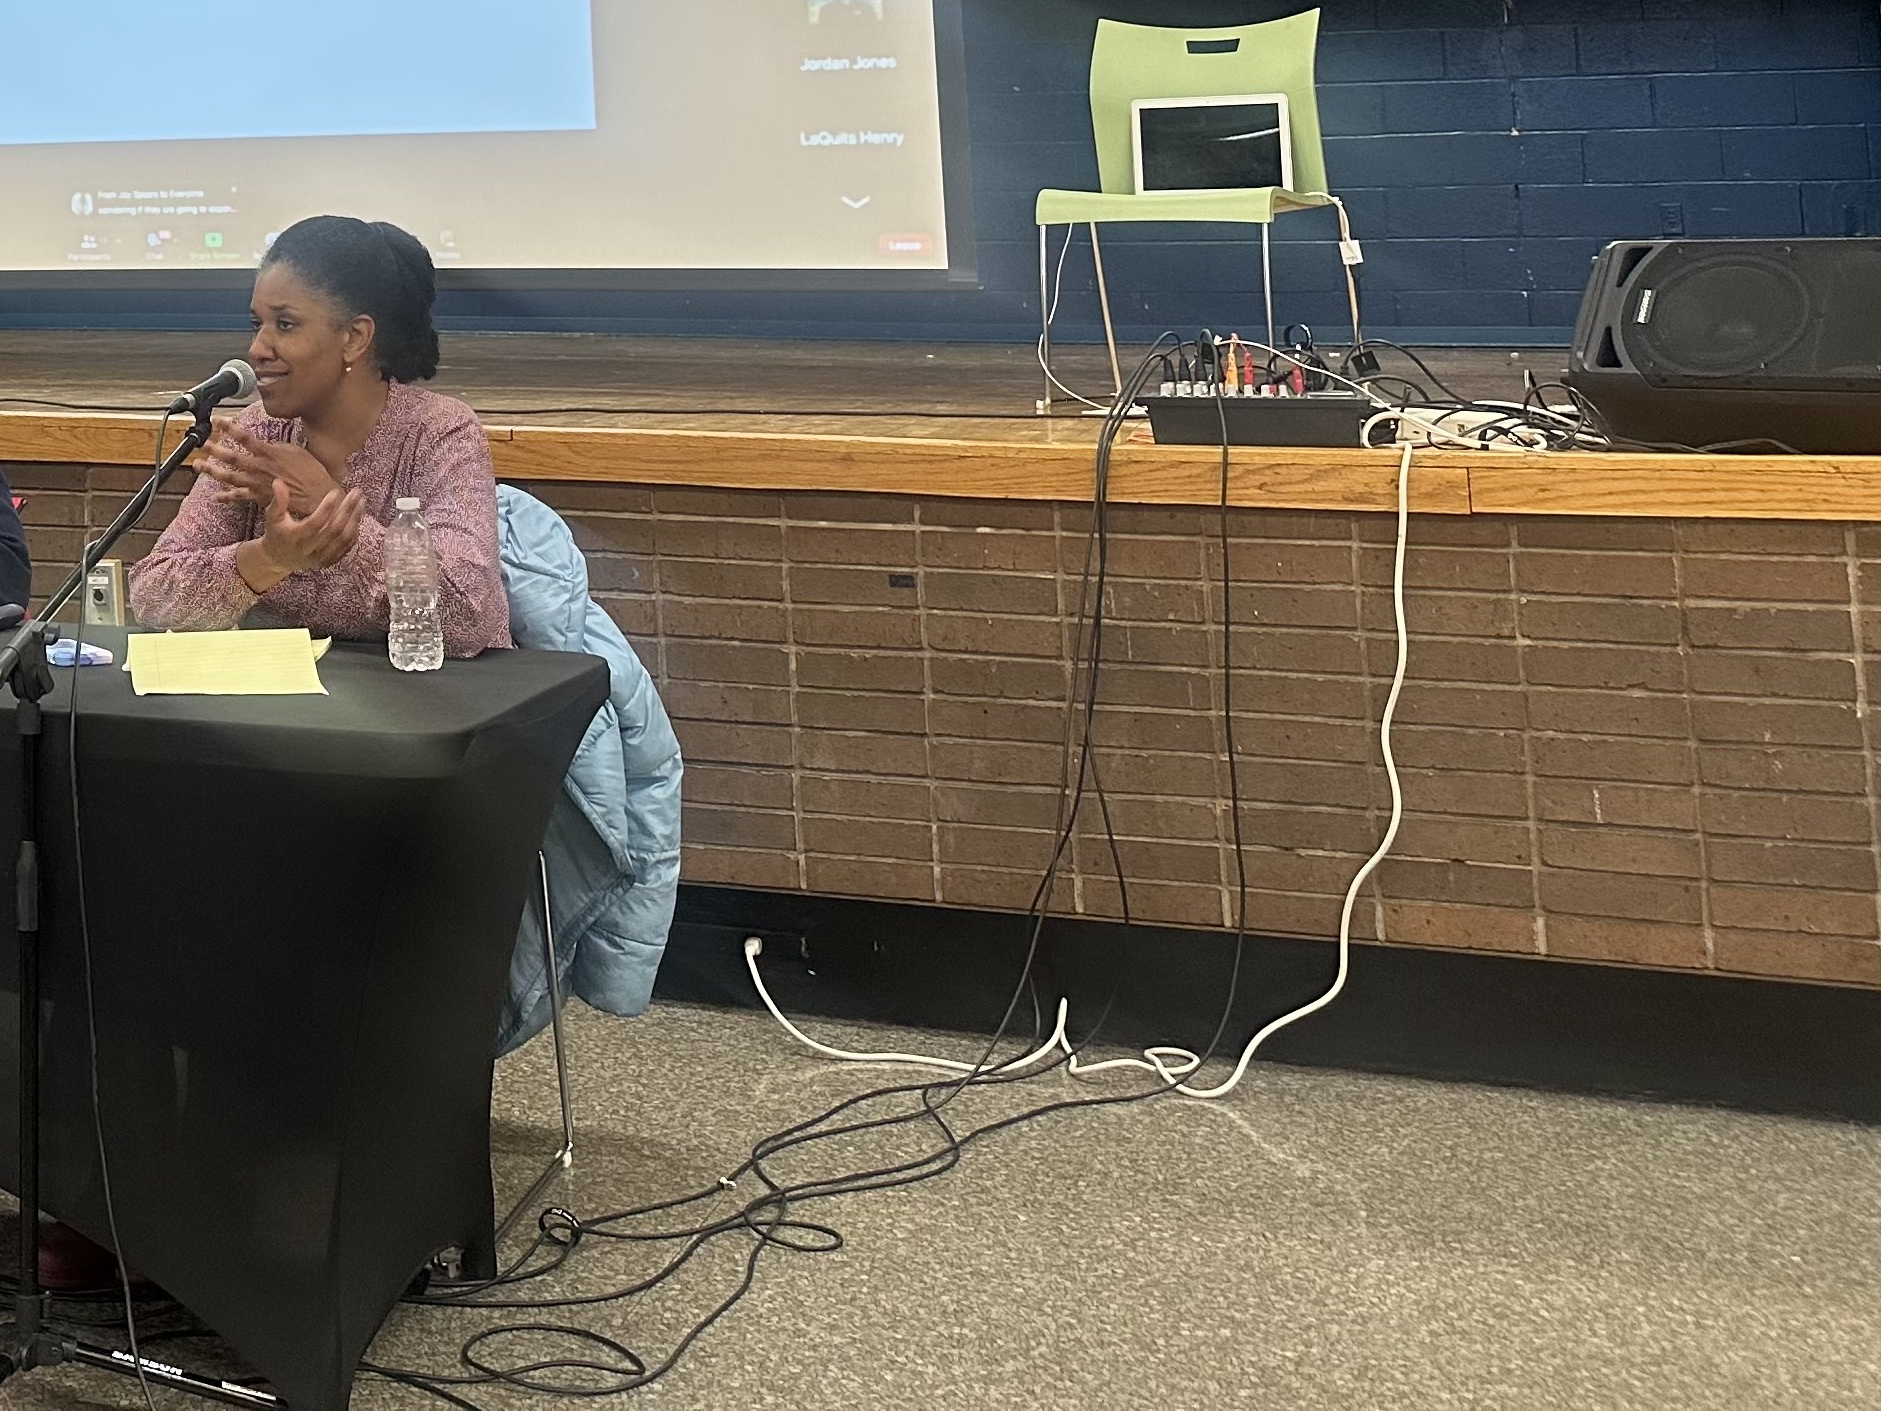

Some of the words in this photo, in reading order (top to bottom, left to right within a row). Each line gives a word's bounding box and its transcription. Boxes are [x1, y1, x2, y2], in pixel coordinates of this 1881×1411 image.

[800, 57, 850, 71] Jordan
[852, 55, 897, 69] Jones
[859, 129, 905, 147] Henry
